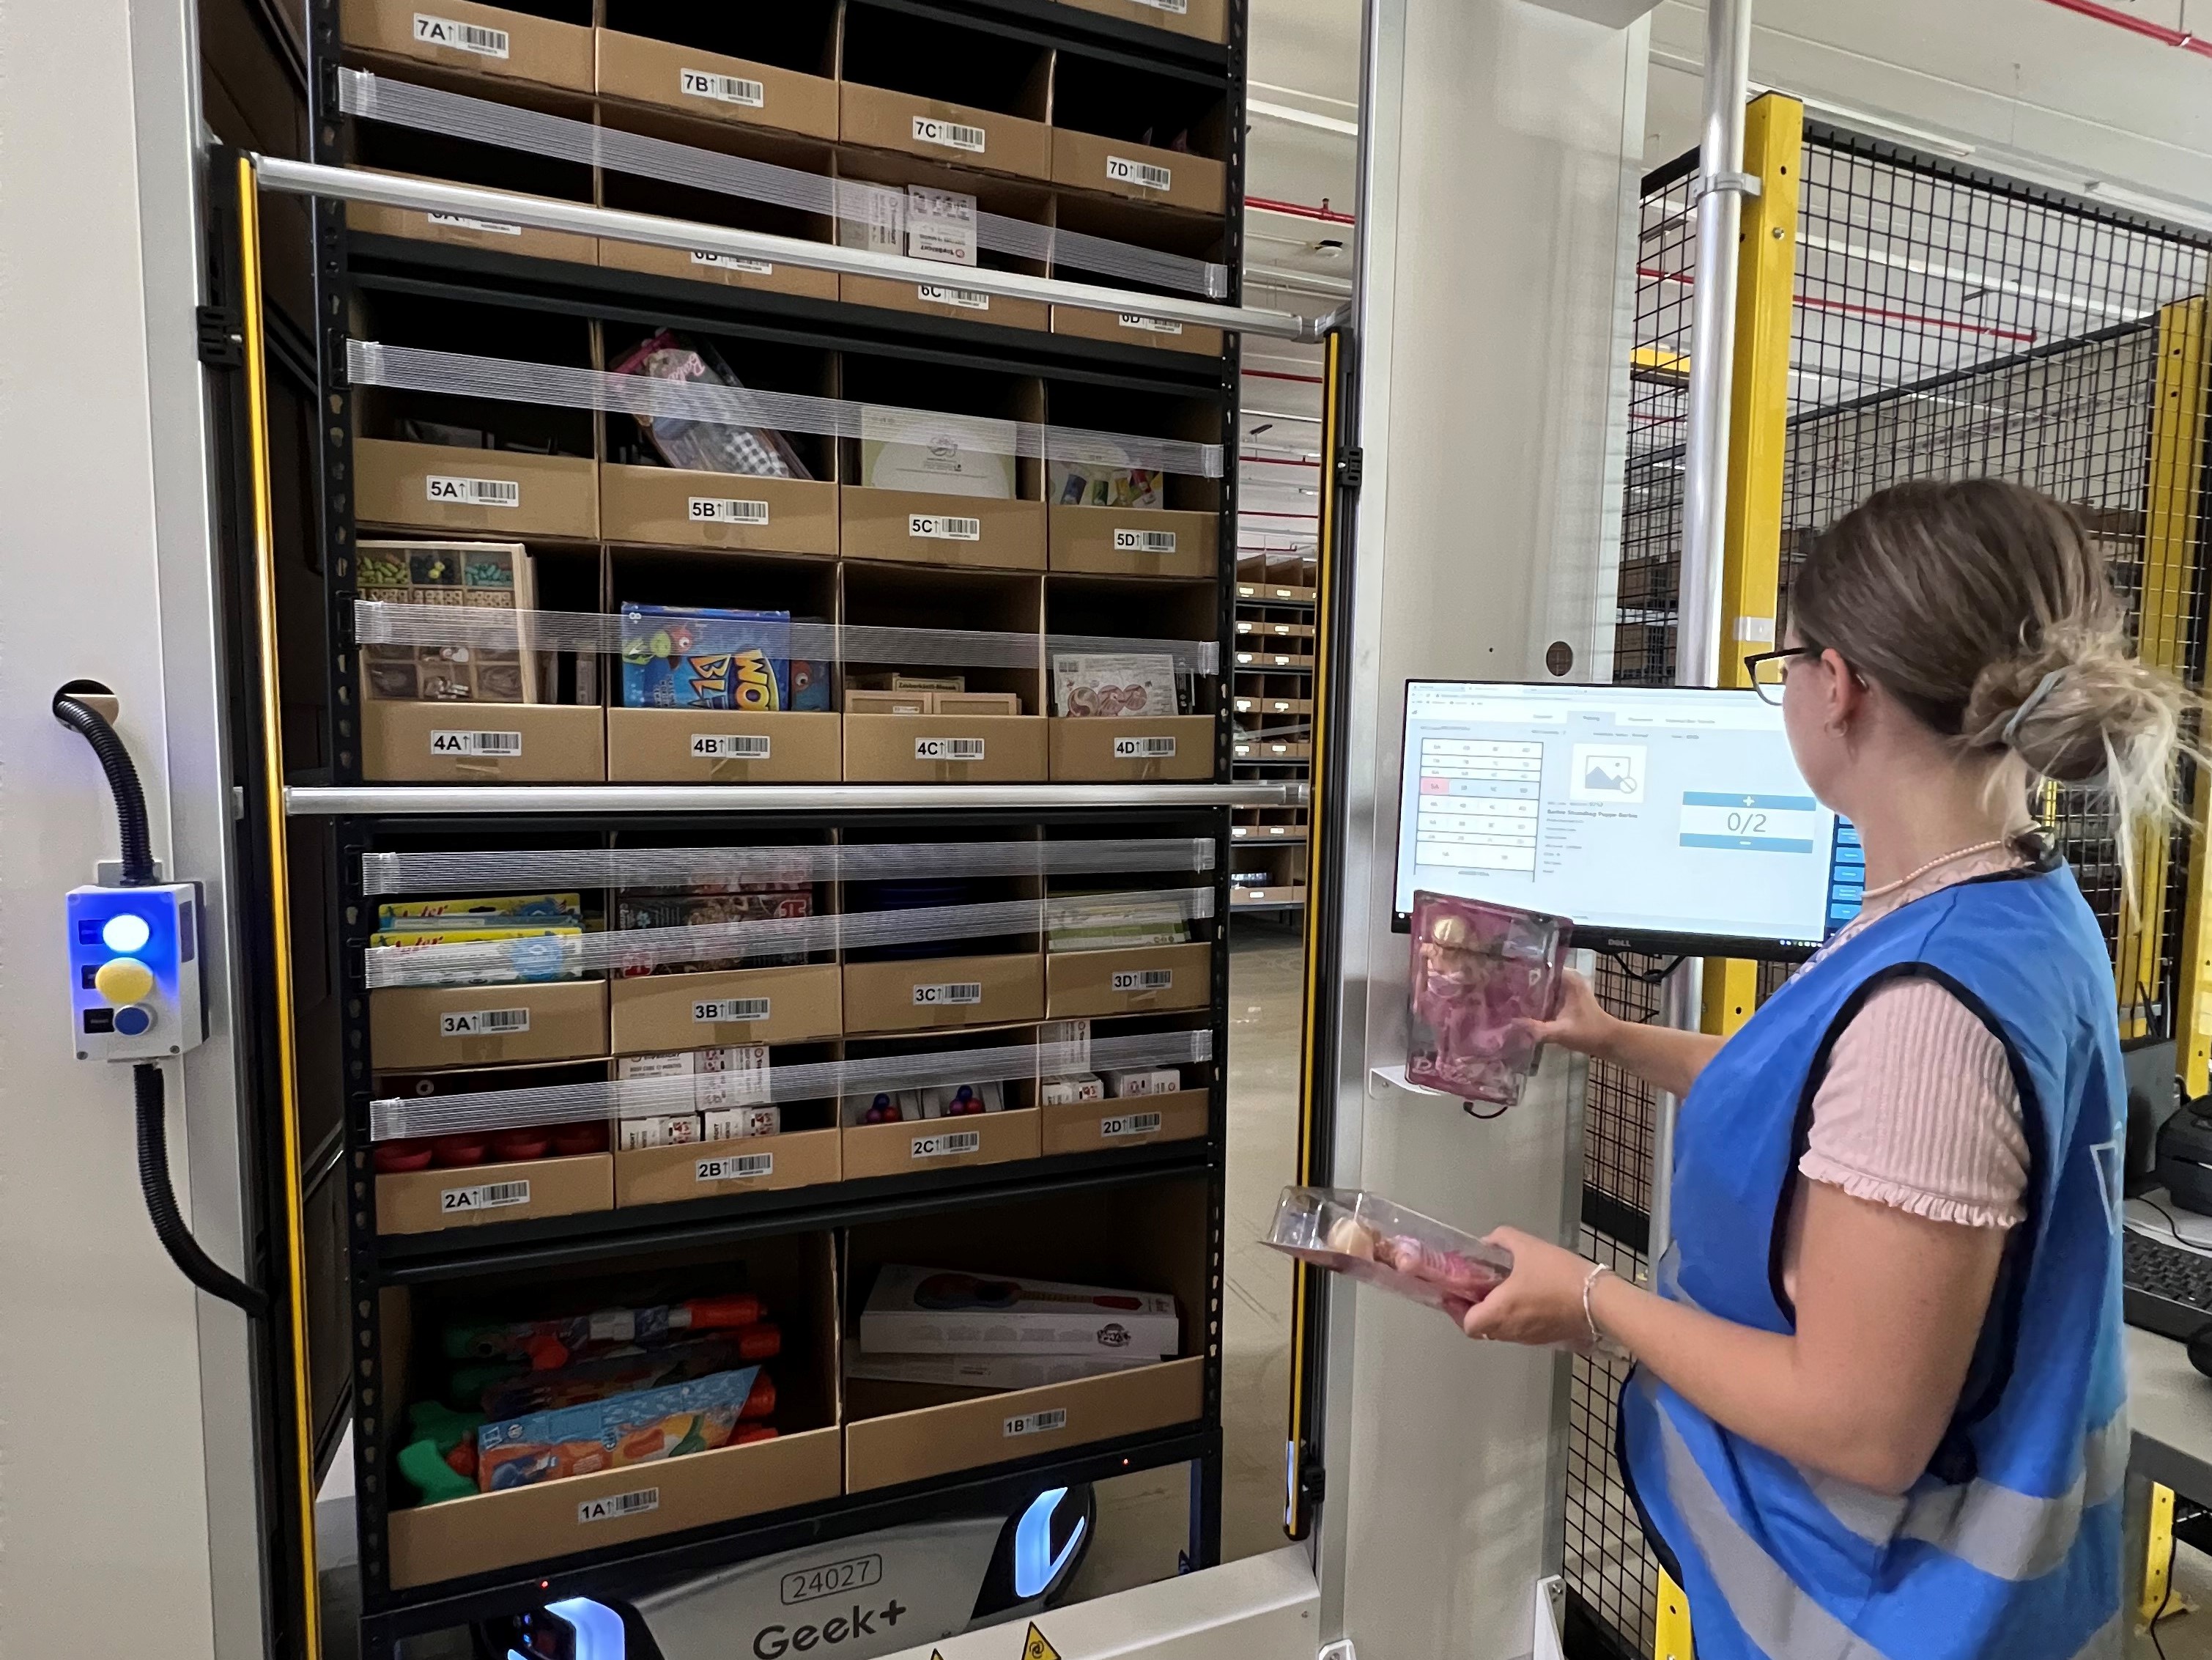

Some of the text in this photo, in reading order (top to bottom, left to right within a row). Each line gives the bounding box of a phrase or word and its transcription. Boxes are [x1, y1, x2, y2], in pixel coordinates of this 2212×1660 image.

[417, 20, 445, 40] 7A
[684, 75, 709, 92] 7B
[916, 122, 936, 138] 7C
[1110, 161, 1128, 176] 7D
[921, 285, 942, 298] 6C
[432, 482, 457, 498] 5A
[692, 503, 715, 517] 5B
[912, 520, 932, 533] 5C
[1117, 534, 1134, 546] 5D
[434, 736, 461, 750] 4A
[694, 739, 717, 753] 4B
[918, 742, 938, 755] 4C
[1117, 742, 1134, 753] 4D
[1727, 813, 1767, 834] 0/2
[1114, 975, 1132, 987] 3D
[917, 989, 936, 1001] 3C
[696, 1005, 717, 1018] 3B
[445, 1017, 470, 1031] 3A
[1103, 1121, 1121, 1133] 2D
[914, 1140, 933, 1154] 2C
[699, 1162, 721, 1177] 2B
[445, 1192, 471, 1209] 2A
[1007, 1420, 1024, 1433] 1B
[582, 1504, 605, 1519] 1A
[792, 1560, 870, 1598] 24027
[753, 1599, 906, 1660] Geek+
